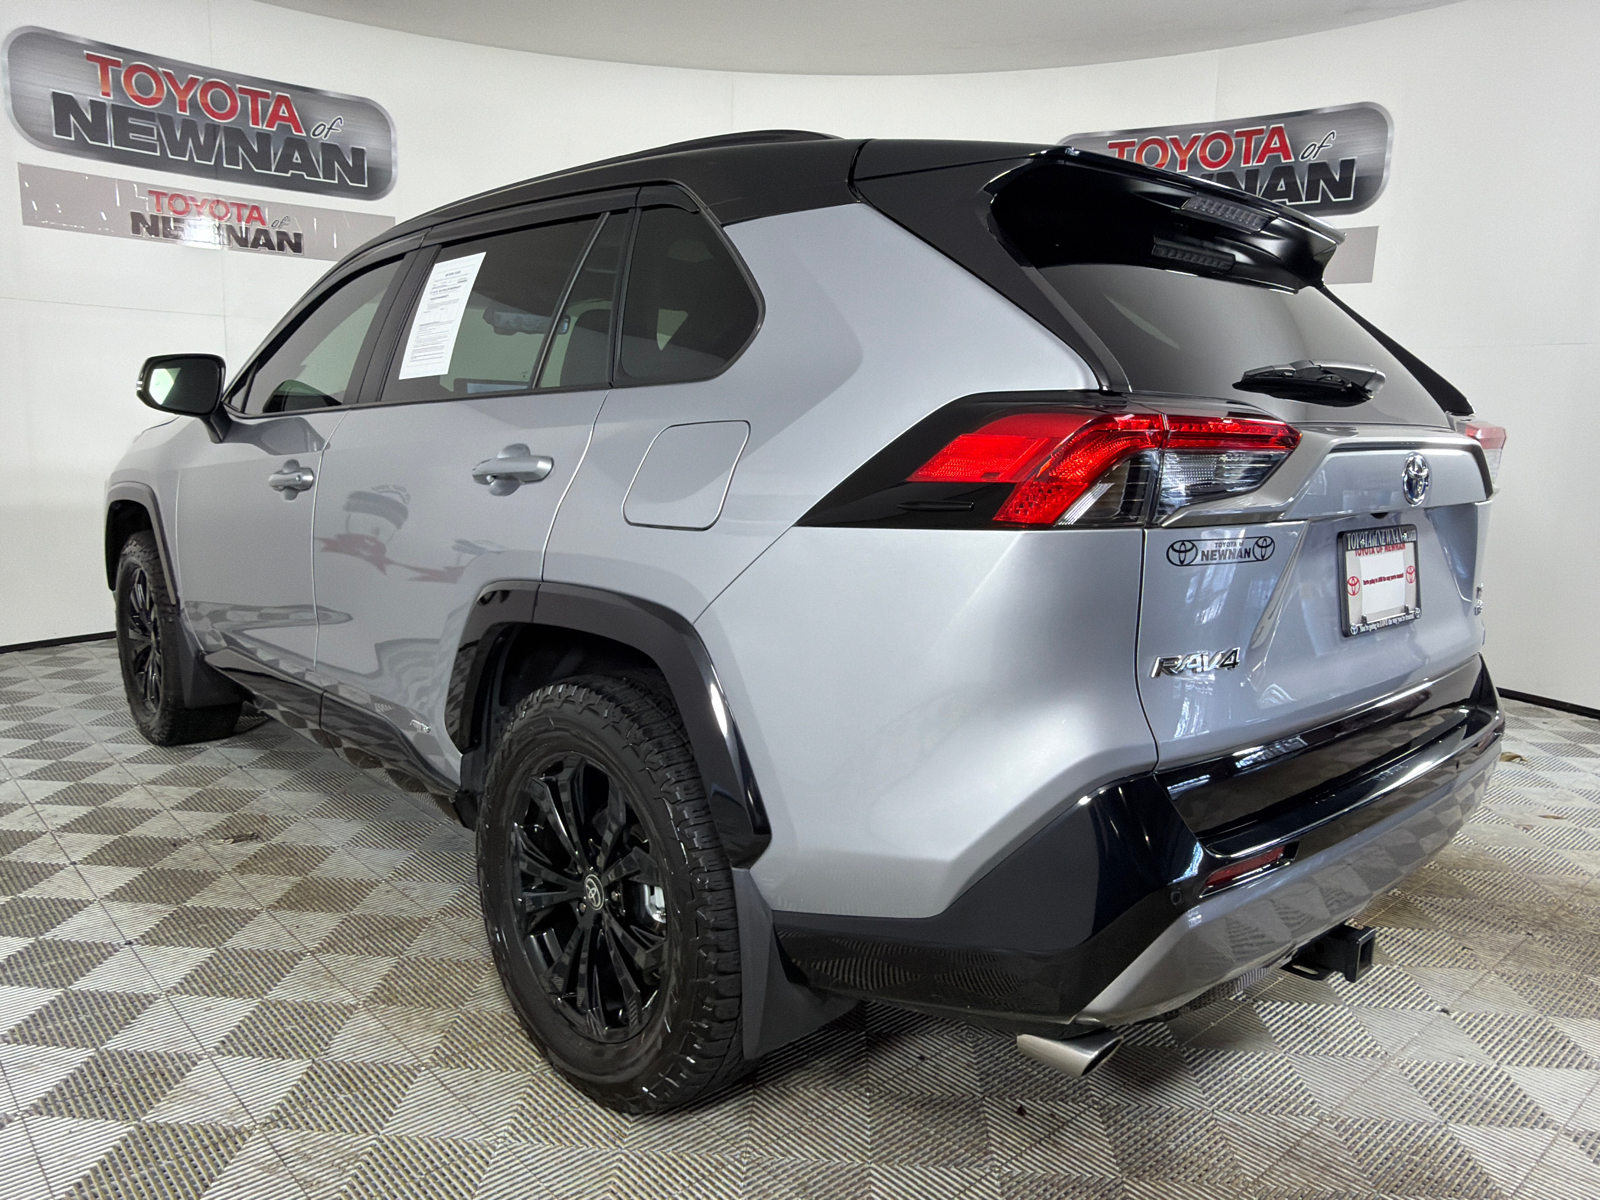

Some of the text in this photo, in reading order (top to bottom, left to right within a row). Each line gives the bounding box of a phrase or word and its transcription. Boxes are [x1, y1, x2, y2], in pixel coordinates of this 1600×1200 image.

[84, 50, 344, 140] TOYOTA of
[51, 90, 368, 188] NEWNAN
[1108, 124, 1336, 172] TOYOTA of
[148, 189, 290, 229] TOYOTA of
[130, 211, 303, 254] NENAN
[1201, 548, 1251, 561] NEWNAN
[1215, 541, 1237, 549] TOYOTA
[1150, 647, 1241, 678] RAV4
